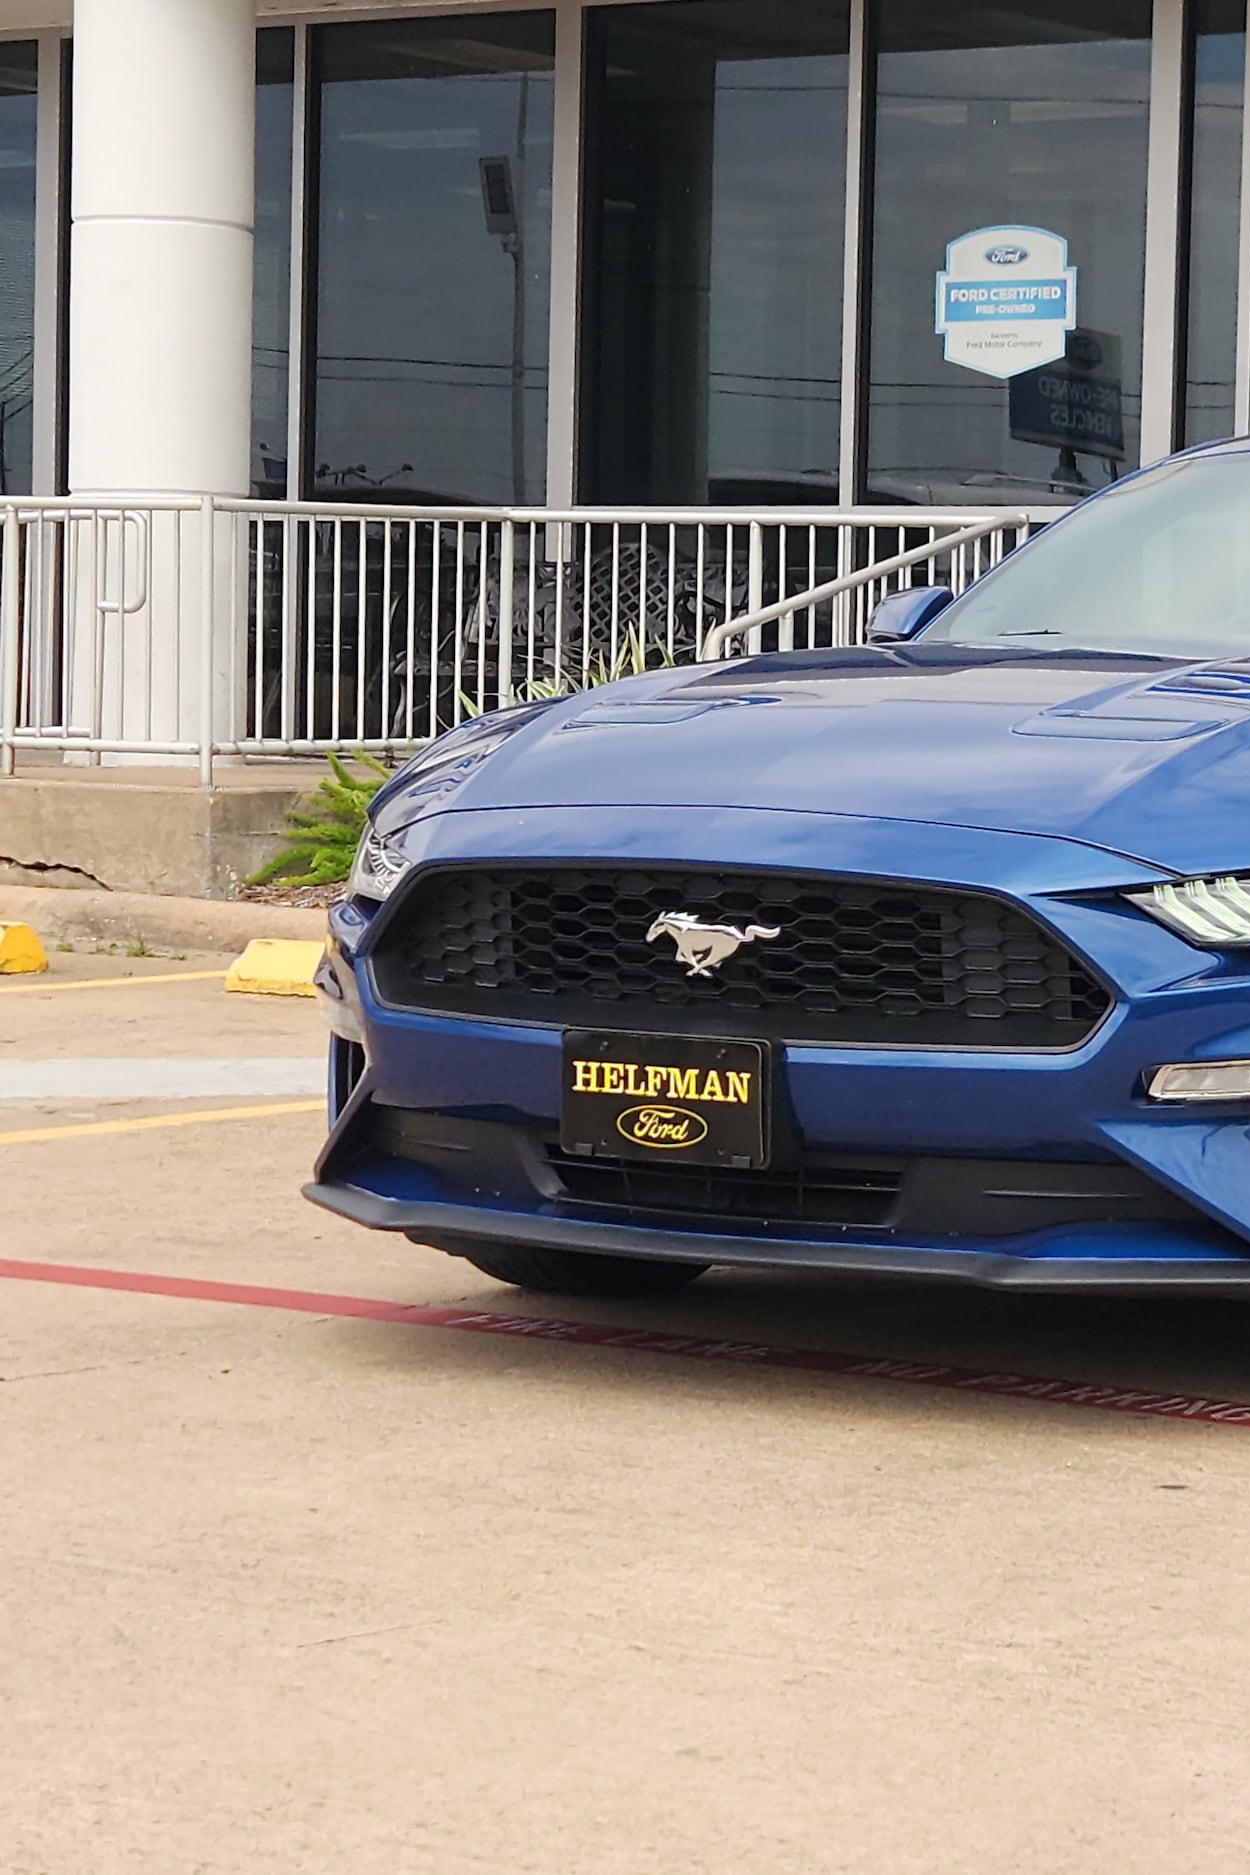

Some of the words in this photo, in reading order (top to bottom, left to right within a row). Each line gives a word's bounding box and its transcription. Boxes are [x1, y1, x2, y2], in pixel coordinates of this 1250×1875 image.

[950, 288, 988, 303] FORD
[990, 286, 1062, 301] CERTIFIED
[572, 1060, 751, 1104] HELFMAN
[633, 1109, 690, 1140] Ford
